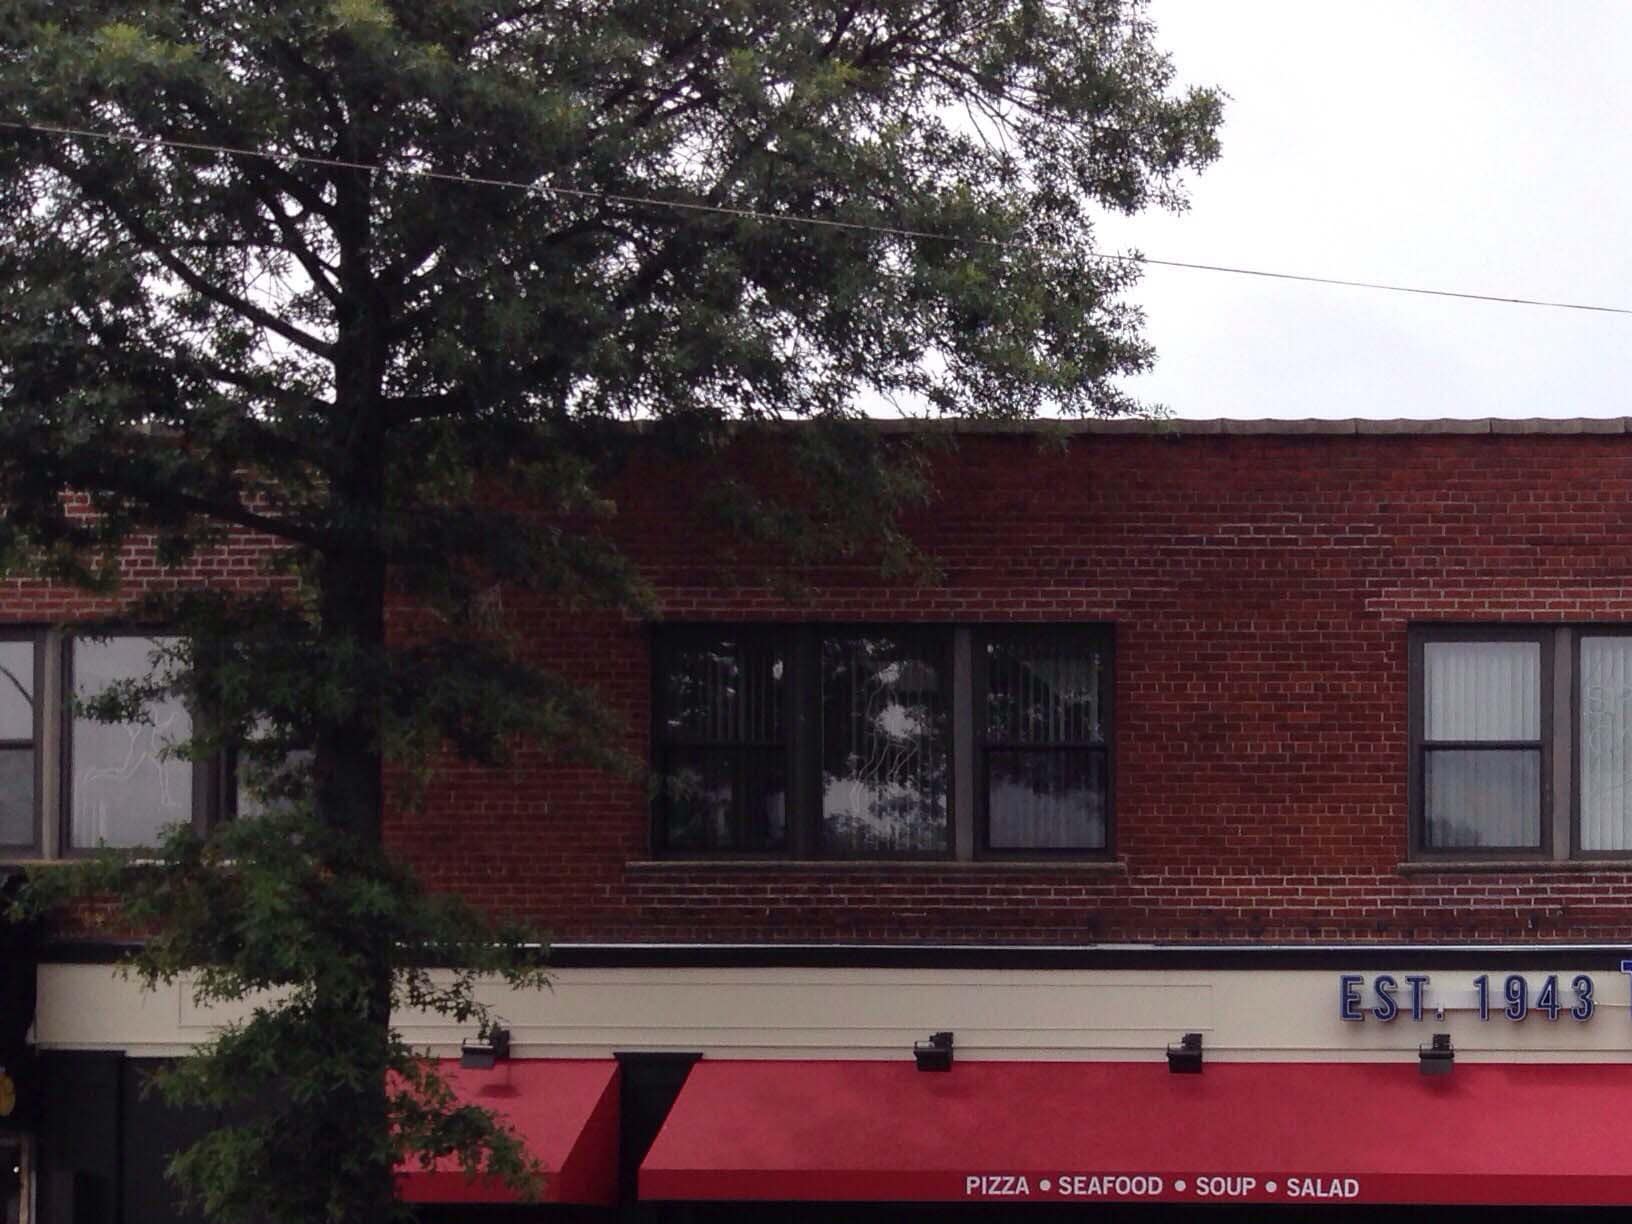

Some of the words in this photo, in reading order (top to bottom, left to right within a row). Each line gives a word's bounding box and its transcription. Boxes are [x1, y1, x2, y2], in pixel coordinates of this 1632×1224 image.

[1340, 974, 1446, 1022] EST.
[1473, 973, 1596, 1022] 1943
[966, 1176, 1030, 1195] PIZZA
[1058, 1176, 1163, 1195] SEAFOOD
[1196, 1177, 1257, 1196] SOUP
[1286, 1178, 1360, 1198] SALAD
